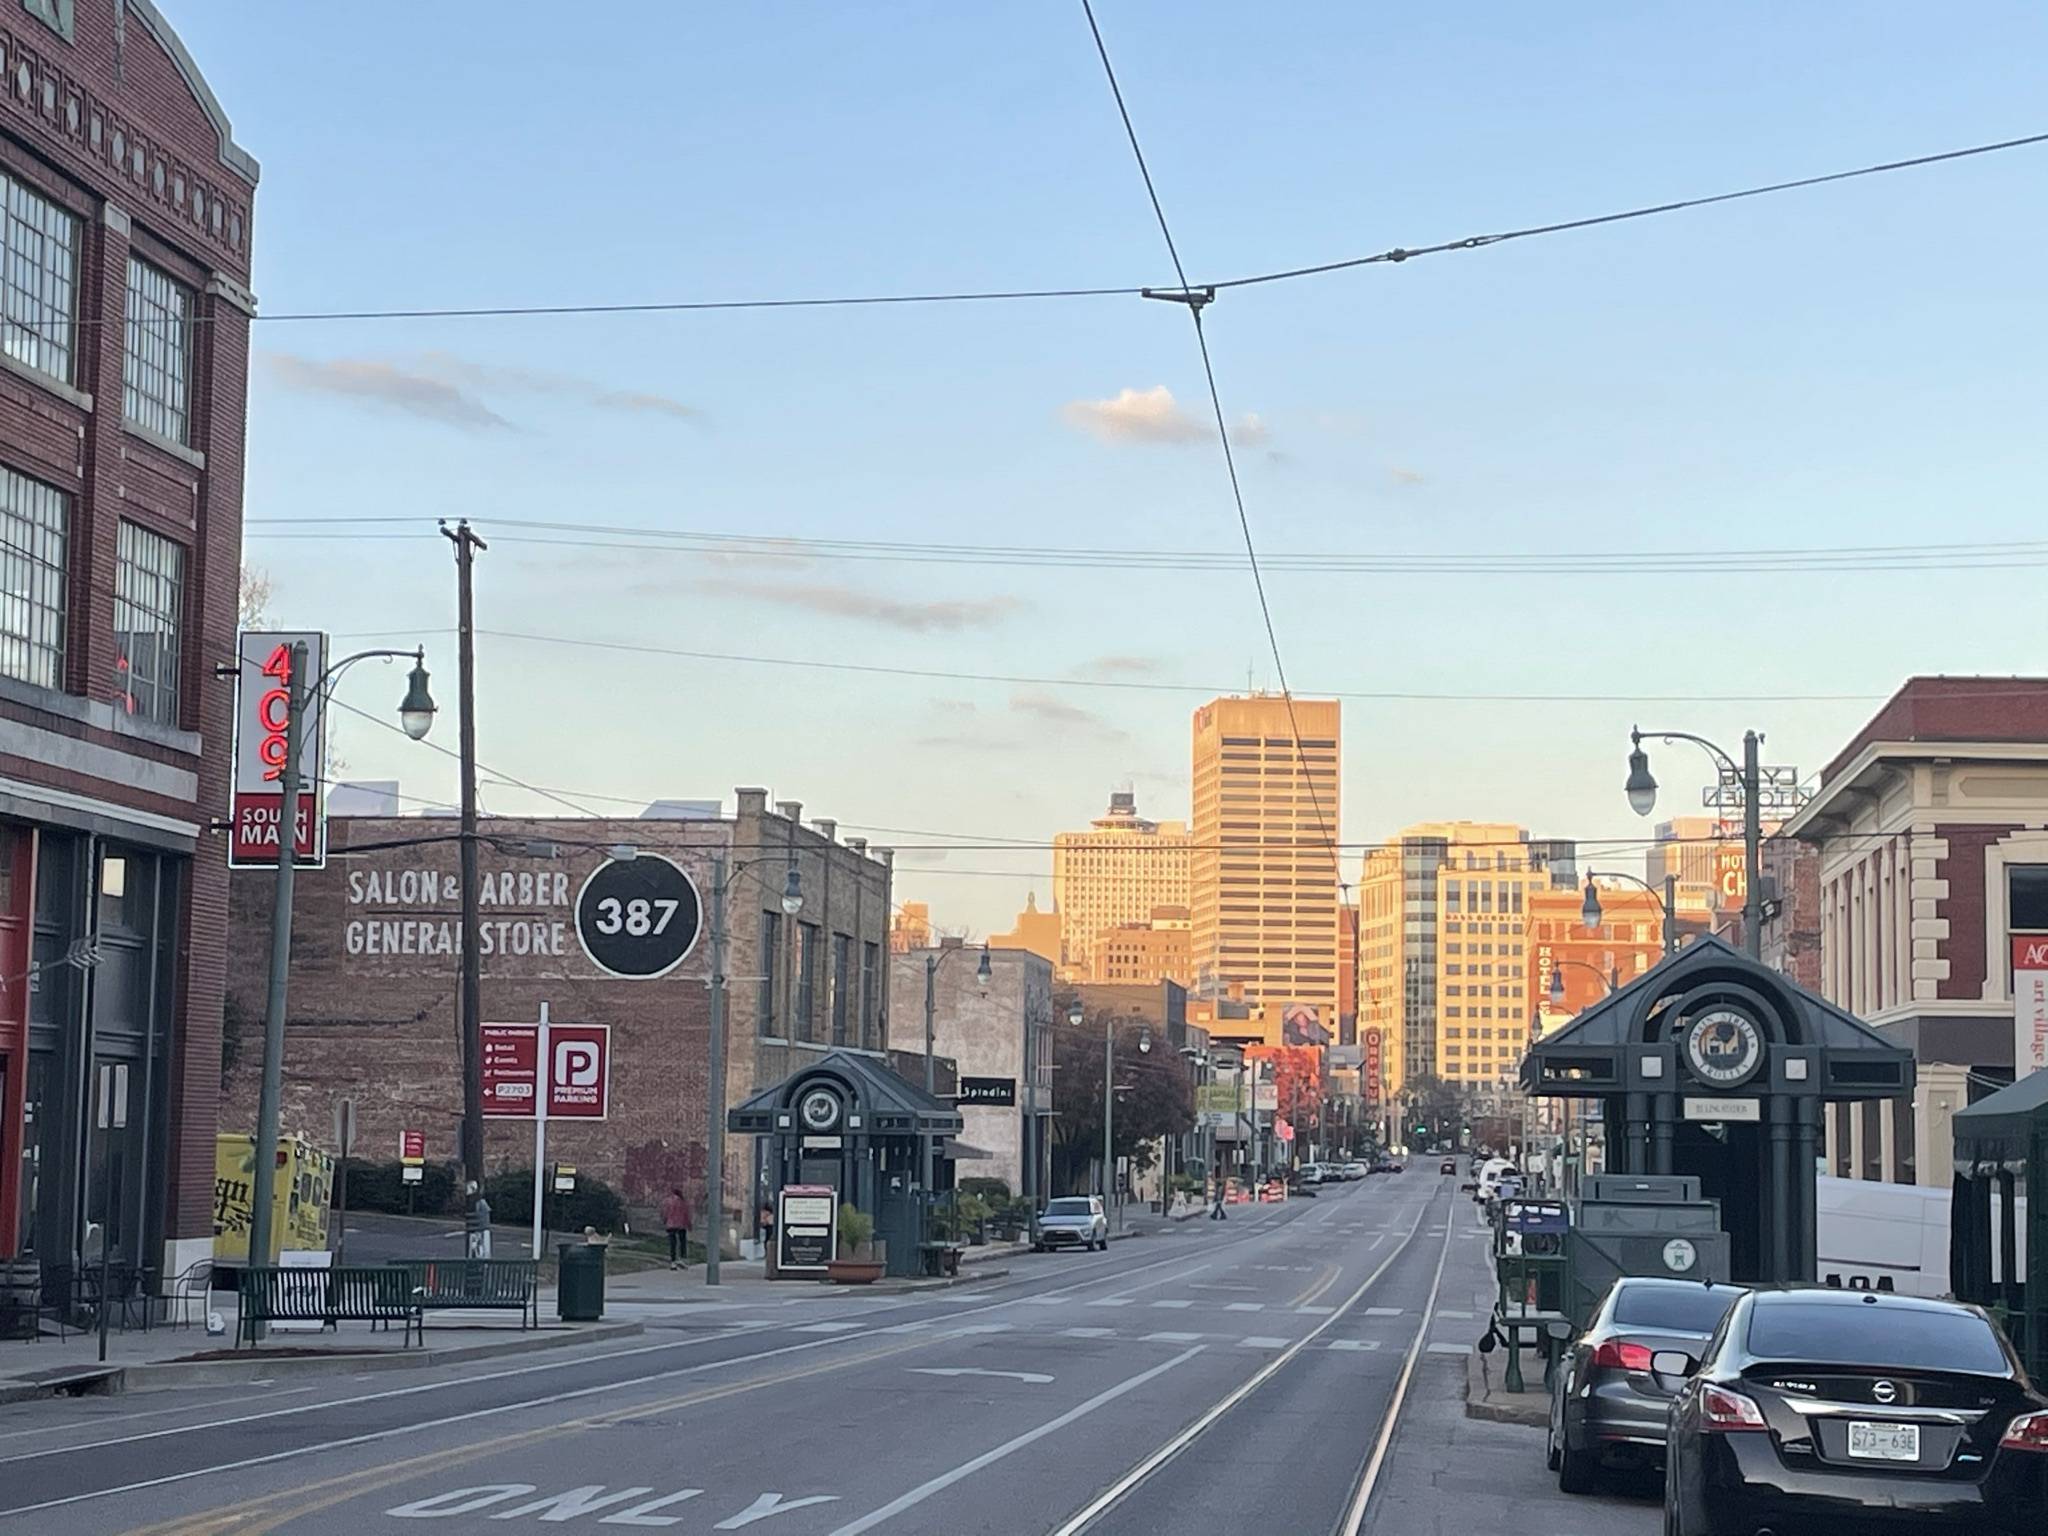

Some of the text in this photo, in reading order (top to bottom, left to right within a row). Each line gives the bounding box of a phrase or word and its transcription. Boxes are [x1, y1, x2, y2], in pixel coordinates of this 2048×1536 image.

[242, 807, 308, 823] SOUH
[241, 825, 307, 845] MAN
[1721, 855, 1747, 870] HOT
[350, 870, 438, 904] SALON
[478, 872, 569, 906] ARBER
[1723, 871, 1748, 897] CH
[596, 897, 680, 937] 387
[479, 921, 566, 955] STORE
[1368, 1033, 1379, 1105] ORPHEU
[497, 1085, 531, 1095] P2703
[553, 1095, 598, 1104] PARKING
[386, 1483, 842, 1530] ONLY
